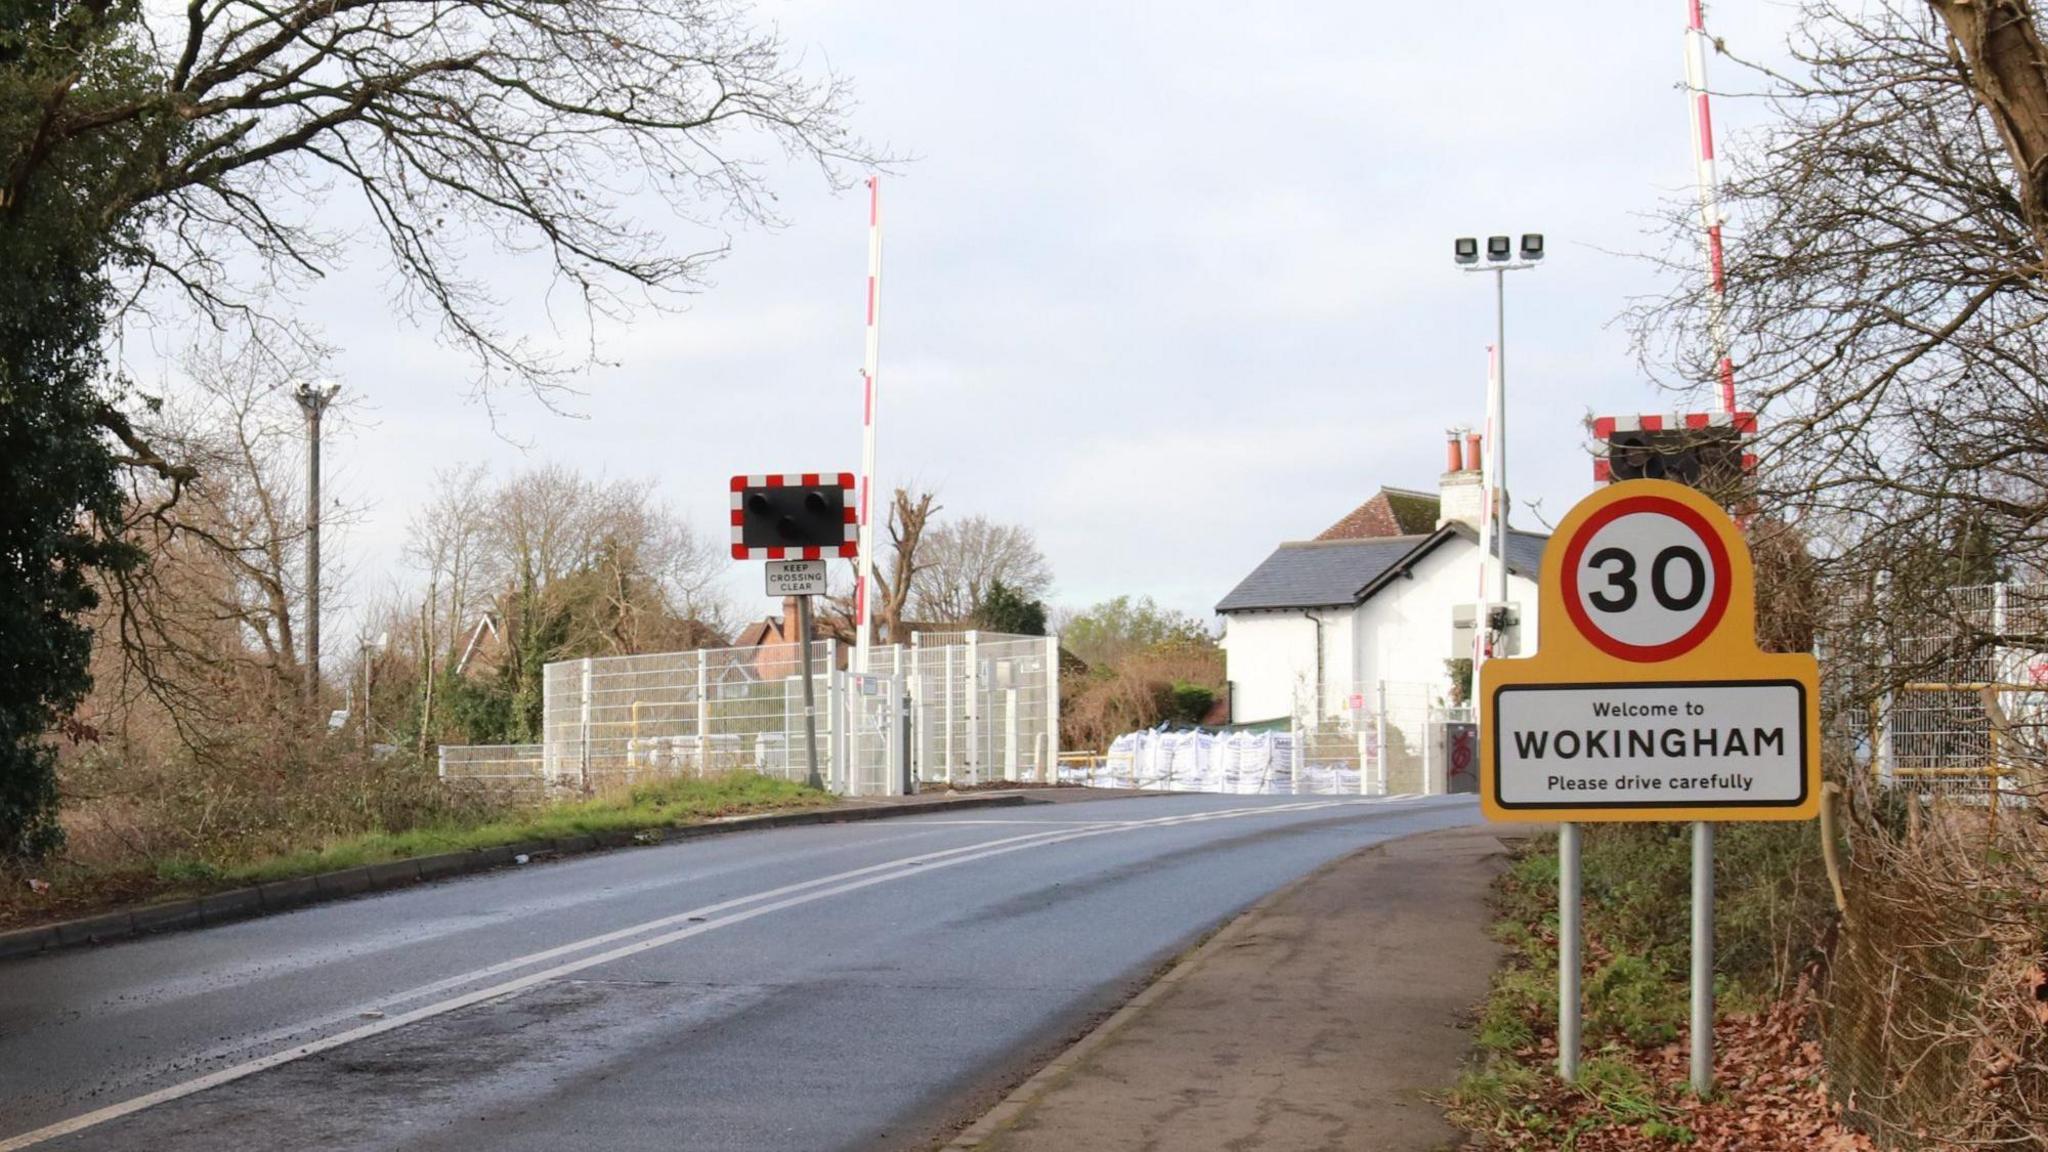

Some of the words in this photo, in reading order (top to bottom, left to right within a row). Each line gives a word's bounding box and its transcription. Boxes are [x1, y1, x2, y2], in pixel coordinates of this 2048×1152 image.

[770, 573, 822, 582] CROSSING
[783, 564, 809, 573] KEEP
[780, 582, 812, 591] CLEAR
[1587, 545, 1706, 613] 30
[1592, 701, 1679, 718] Welcome
[1685, 700, 1705, 717] to
[1513, 726, 1785, 760] WOKINGHAM
[1547, 775, 1609, 791] Please
[1614, 774, 1663, 791] drive
[1668, 773, 1754, 793] carefully
